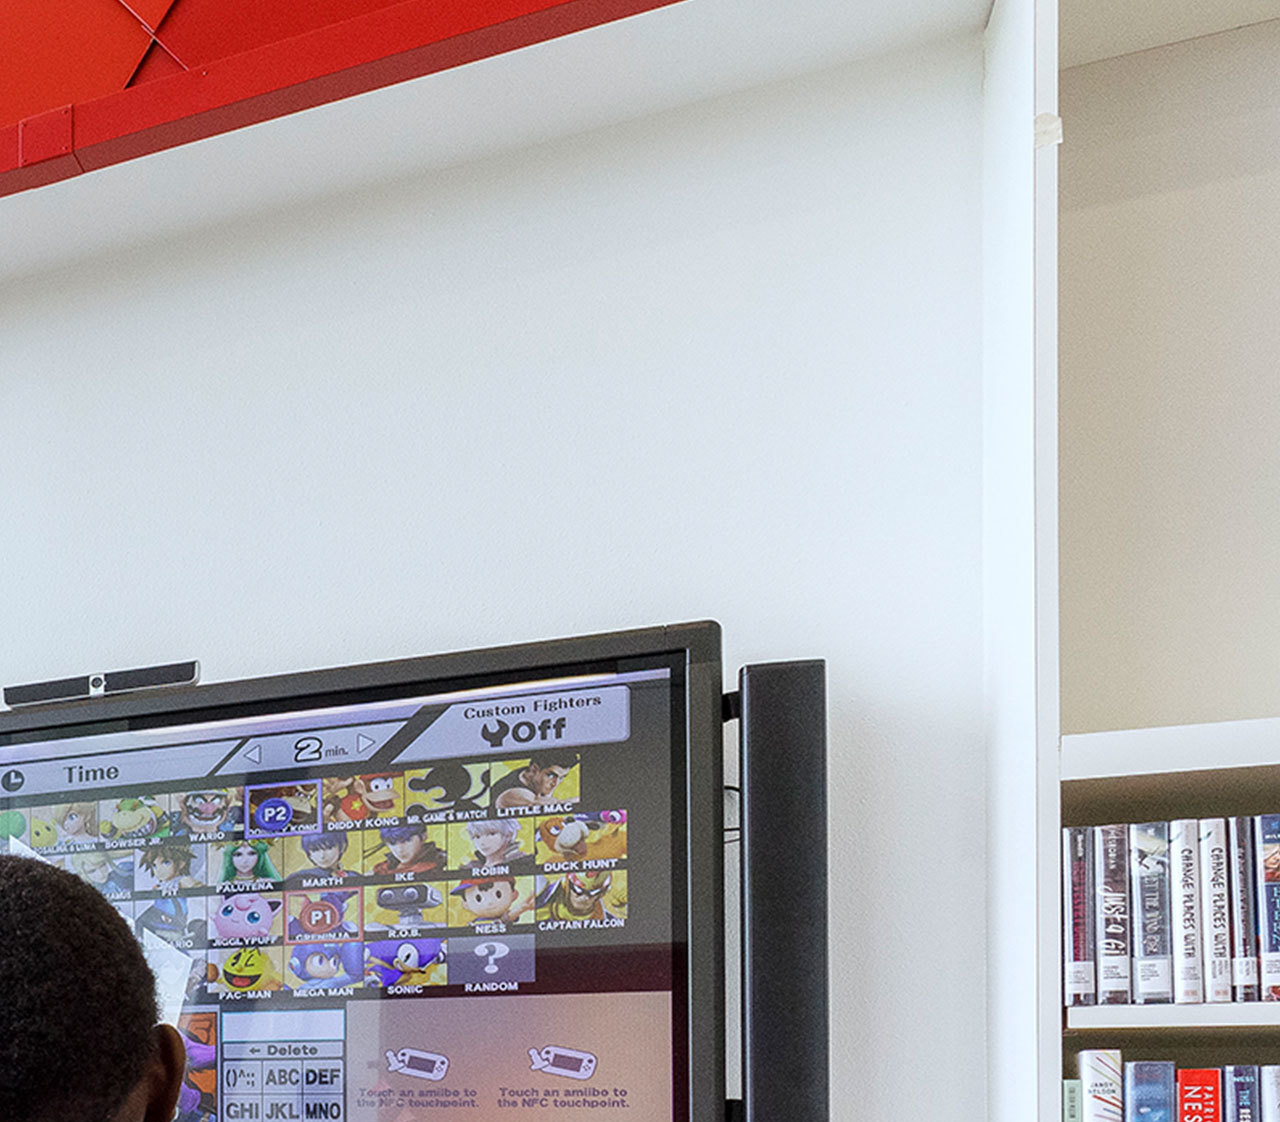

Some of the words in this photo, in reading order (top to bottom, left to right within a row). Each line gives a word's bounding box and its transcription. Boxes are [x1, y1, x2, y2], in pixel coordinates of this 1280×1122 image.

[463, 703, 526, 721] Custom
[532, 694, 602, 713] Fighters
[512, 716, 567, 742] Off
[293, 736, 323, 763] 2
[324, 743, 349, 757] min.
[63, 765, 120, 784] Time
[263, 806, 287, 823] P2
[496, 804, 542, 818] LITTLE
[543, 802, 574, 815] MAC
[327, 818, 363, 831] DIDDY
[364, 816, 400, 829] KONG
[104, 838, 146, 850] BOWSER
[189, 831, 226, 843] WARIO
[471, 865, 510, 877] ROBIN
[543, 861, 578, 873] DUCK
[582, 858, 619, 871] HUNT
[1180, 848, 1195, 889] CHANGE
[1210, 847, 1225, 889] CHANGE
[302, 877, 344, 888] MARTH
[394, 871, 415, 882] IKE
[310, 909, 332, 925] P1
[1182, 893, 1197, 930] PLACES
[1212, 893, 1227, 930] PLACES
[474, 924, 508, 935] NESS
[538, 919, 582, 931] CAPTAIN
[582, 917, 626, 930] FALCON
[1183, 933, 1197, 959] WITH
[1213, 932, 1227, 959] WITH
[326, 986, 354, 998] MAN
[386, 984, 424, 996] SONIC
[464, 981, 519, 993] RANDOM
[267, 1044, 319, 1056] Delete
[264, 1069, 300, 1086] ABC
[305, 1069, 341, 1086] DEF
[499, 1087, 539, 1098] Touch
[543, 1089, 560, 1098] an
[613, 1088, 628, 1098] to
[1239, 1089, 1251, 1106] THE
[225, 1102, 259, 1120] GHI
[264, 1102, 300, 1120] JKL
[305, 1102, 341, 1120] MNO
[497, 1098, 518, 1109] the
[521, 1098, 549, 1109] NFC
